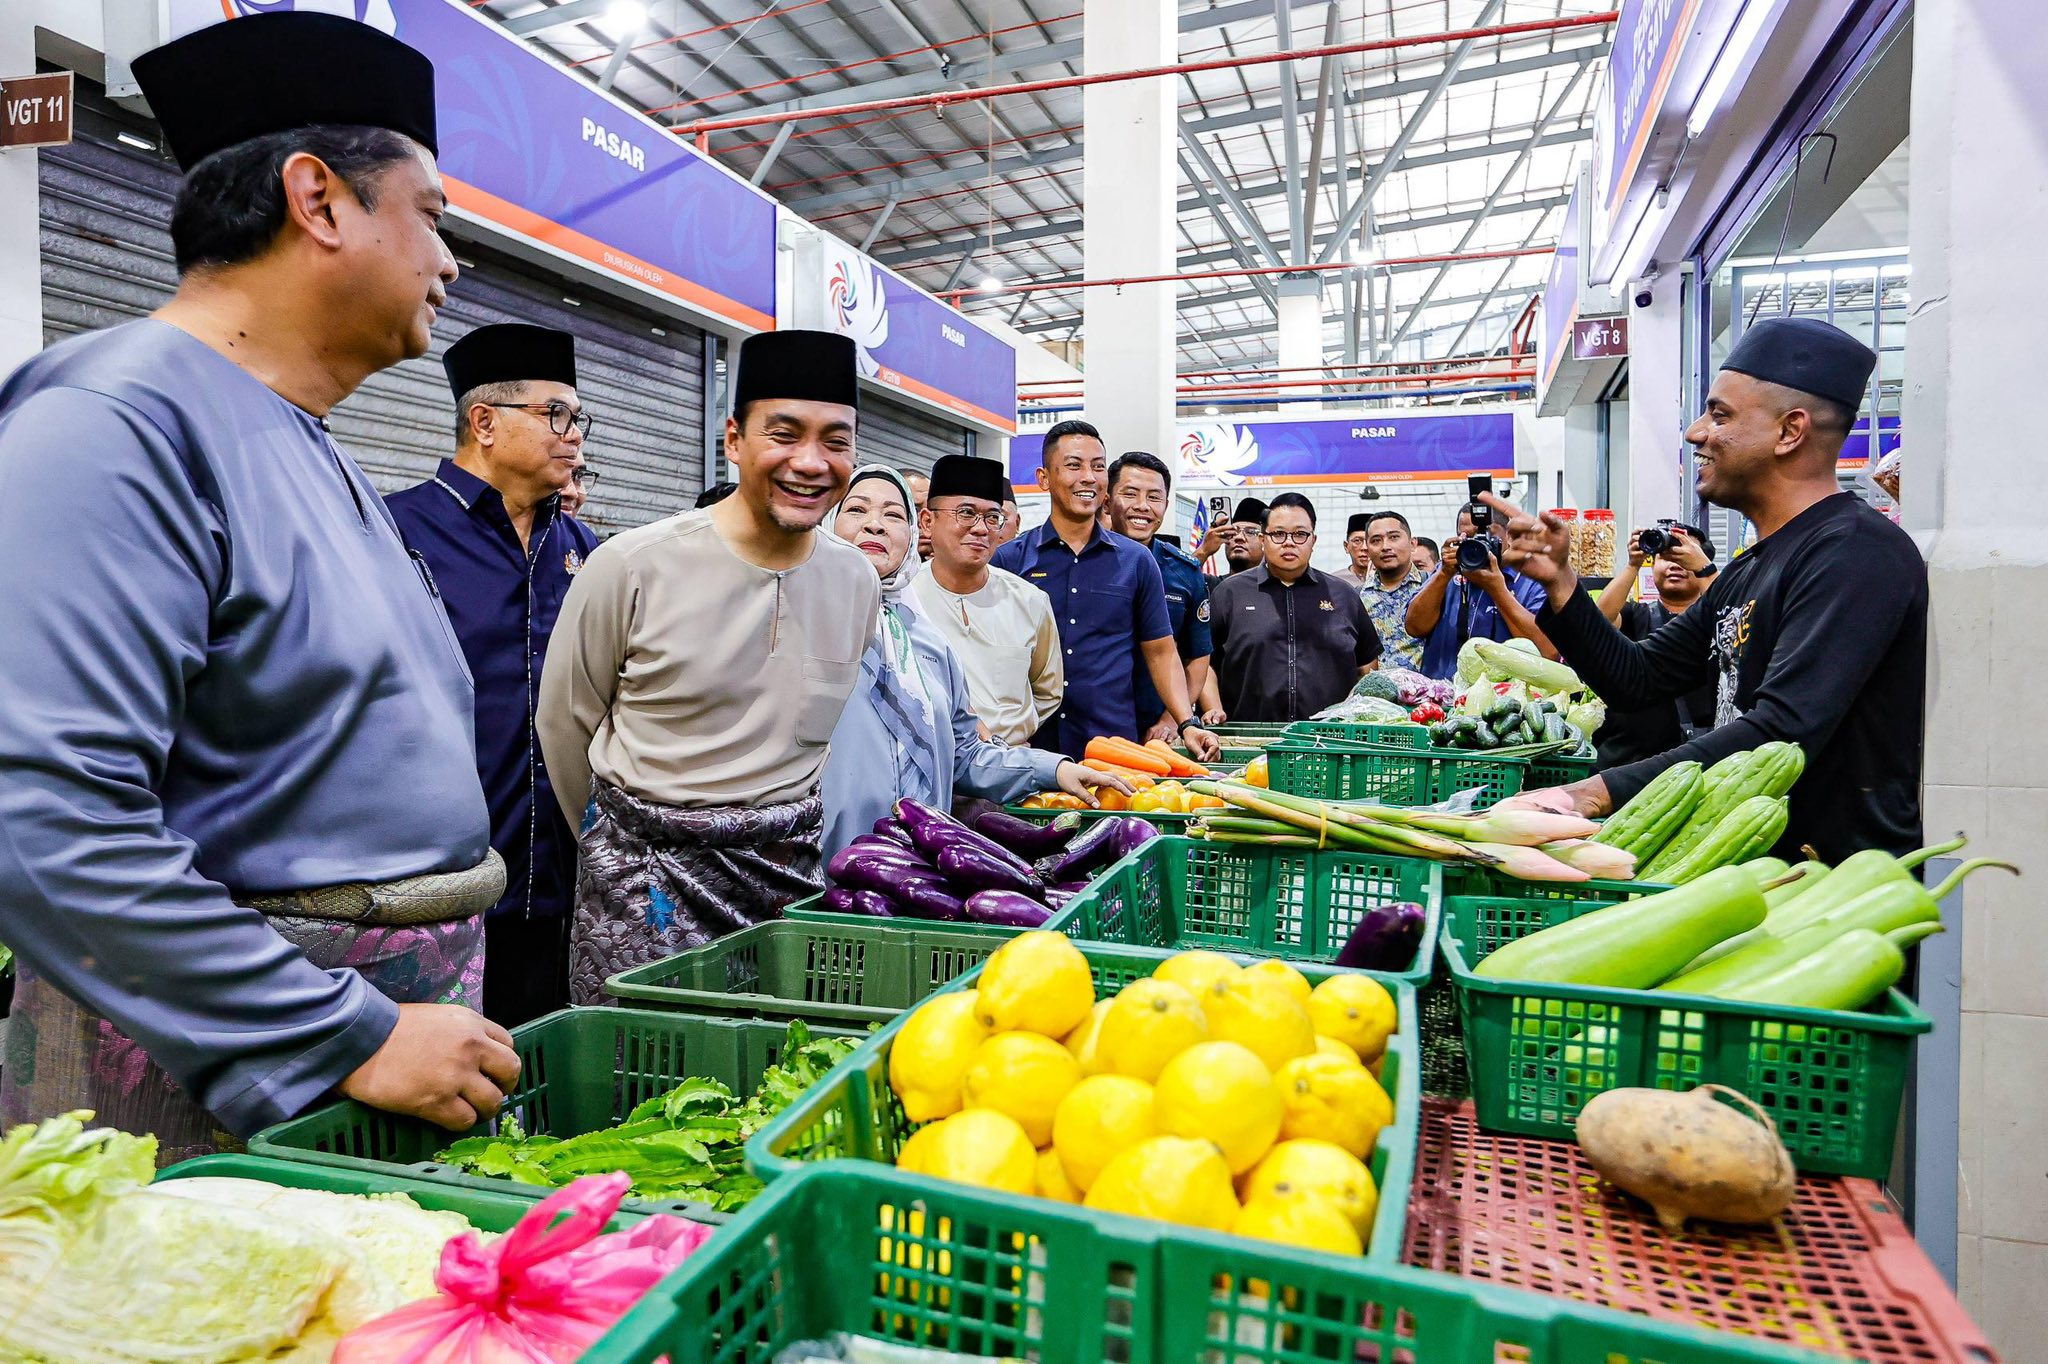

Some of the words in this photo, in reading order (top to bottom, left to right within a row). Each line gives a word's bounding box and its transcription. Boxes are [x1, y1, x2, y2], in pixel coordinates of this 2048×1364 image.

[7, 97, 43, 126] VGT
[47, 95, 63, 122] 11
[582, 116, 645, 172] PASAR
[941, 323, 966, 348] PASAR
[1581, 330, 1609, 346] VGT
[1612, 329, 1621, 345] 8
[1351, 426, 1396, 438] PASAR
